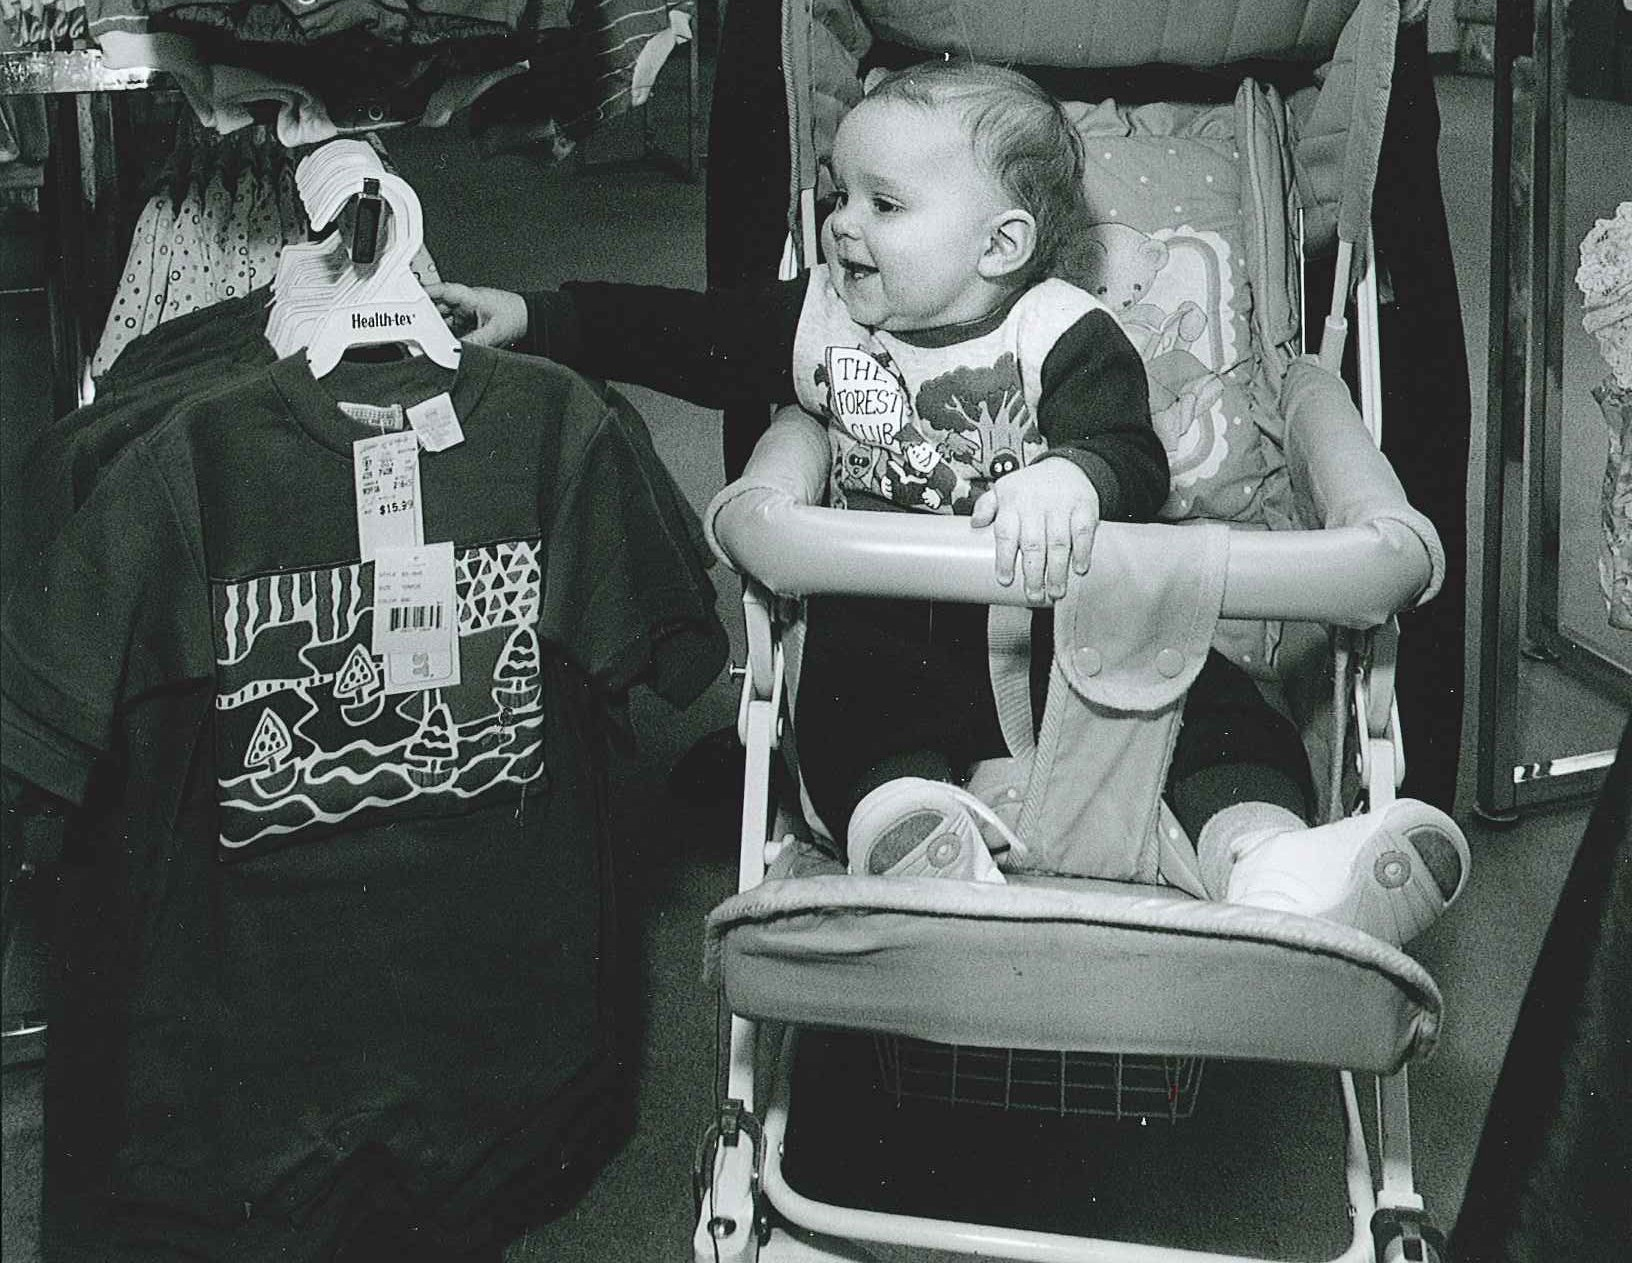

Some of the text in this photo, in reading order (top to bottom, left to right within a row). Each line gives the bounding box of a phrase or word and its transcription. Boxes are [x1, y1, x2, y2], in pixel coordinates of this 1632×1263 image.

[351, 312, 414, 330] Health-tex
[837, 357, 888, 384] THE
[836, 388, 899, 416] FOREST
[850, 422, 894, 446] CLUB
[379, 500, 414, 516] $15.99
